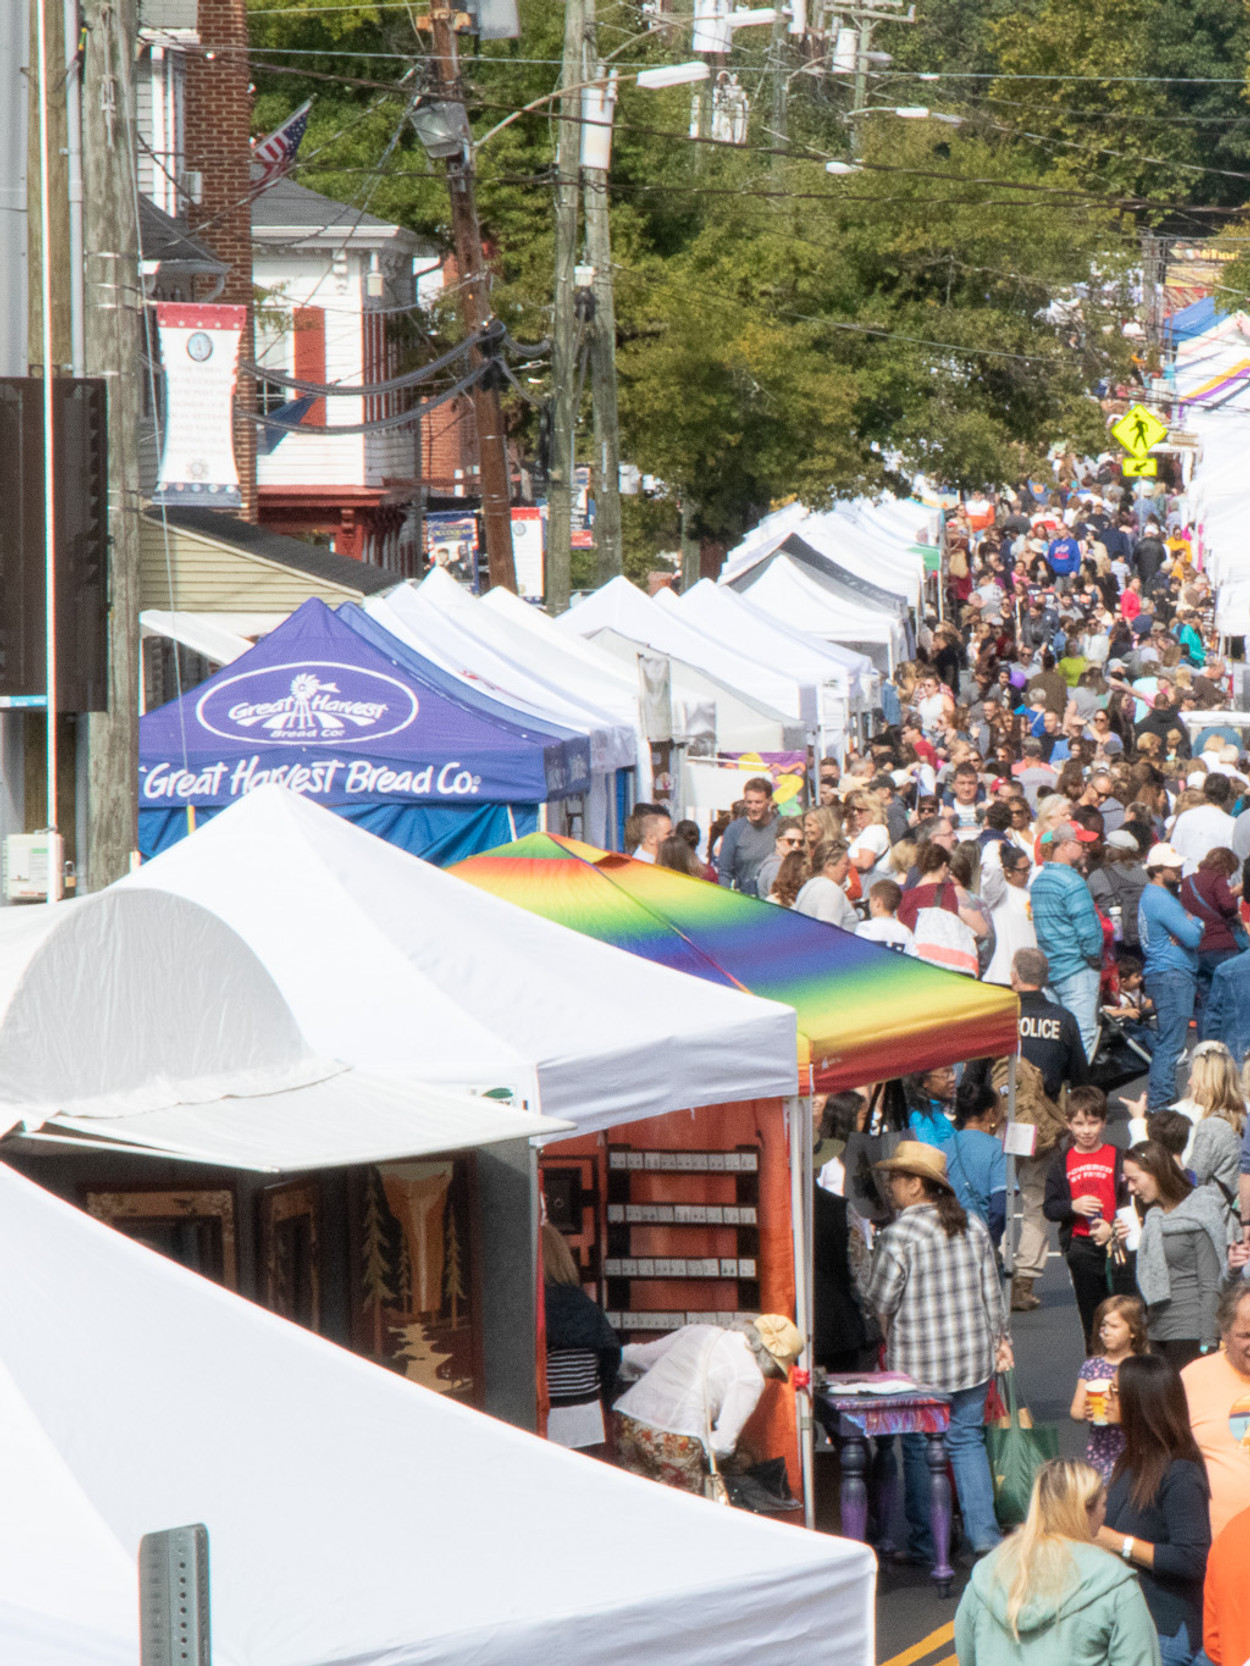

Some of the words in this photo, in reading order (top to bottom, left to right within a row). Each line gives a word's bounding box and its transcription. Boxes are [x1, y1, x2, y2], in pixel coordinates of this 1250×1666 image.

[228, 698, 295, 721] Great
[311, 694, 390, 721] Harvest
[269, 728, 318, 739] Bread
[143, 761, 229, 799] Great
[229, 754, 346, 796] Harvest
[345, 760, 434, 796] Bread
[1018, 1016, 1061, 1041] OLICE
